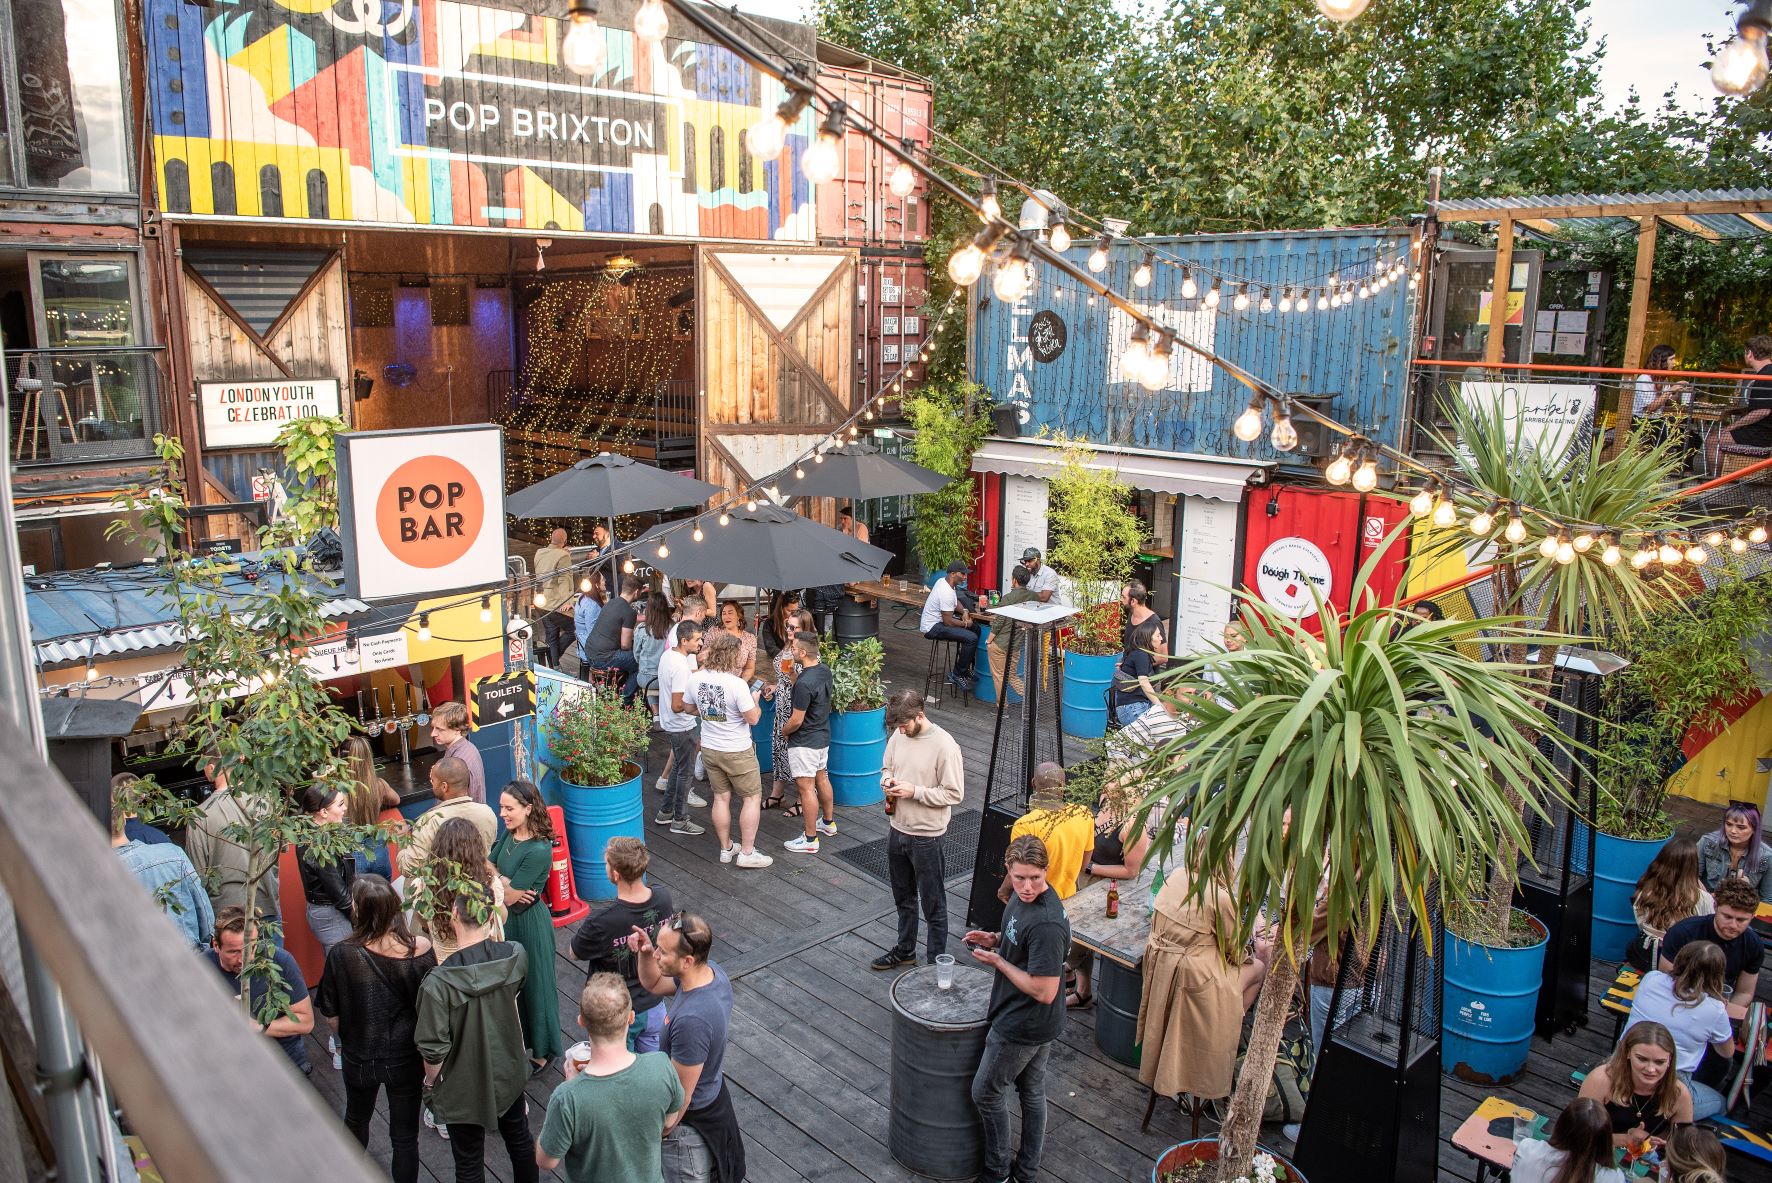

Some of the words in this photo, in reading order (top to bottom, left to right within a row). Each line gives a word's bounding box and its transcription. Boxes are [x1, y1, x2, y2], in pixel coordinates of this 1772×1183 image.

[424, 98, 500, 133] POP
[512, 108, 654, 147] BRIXTON
[220, 387, 270, 404] LONDON
[272, 385, 314, 401] YOUTH
[398, 482, 465, 513] POP
[400, 512, 465, 543] BAR
[1262, 564, 1290, 581] Dough
[484, 684, 523, 701] TOILETS
